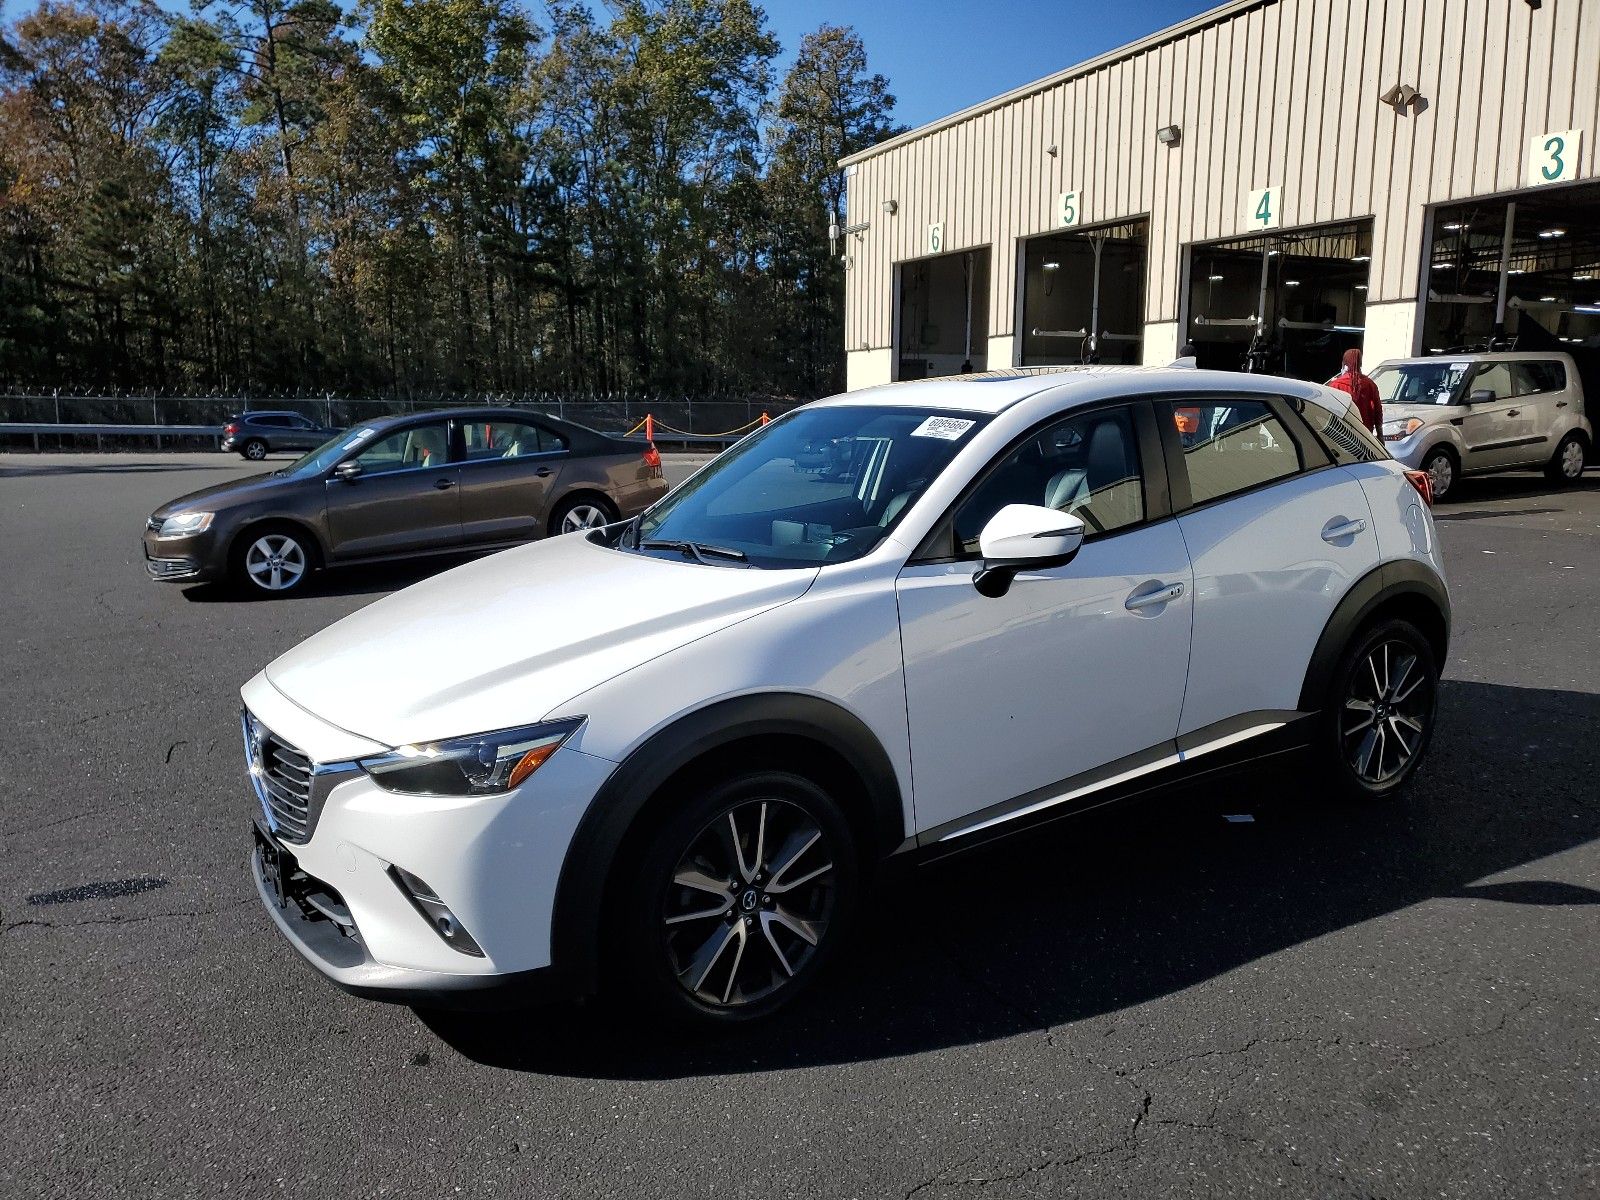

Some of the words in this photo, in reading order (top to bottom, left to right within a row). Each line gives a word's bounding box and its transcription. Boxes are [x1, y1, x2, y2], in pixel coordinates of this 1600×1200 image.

[1542, 136, 1564, 181] 3
[1063, 193, 1075, 225] 5
[1255, 190, 1272, 226] 4
[931, 226, 941, 252] 6
[928, 418, 970, 430] 6095660
